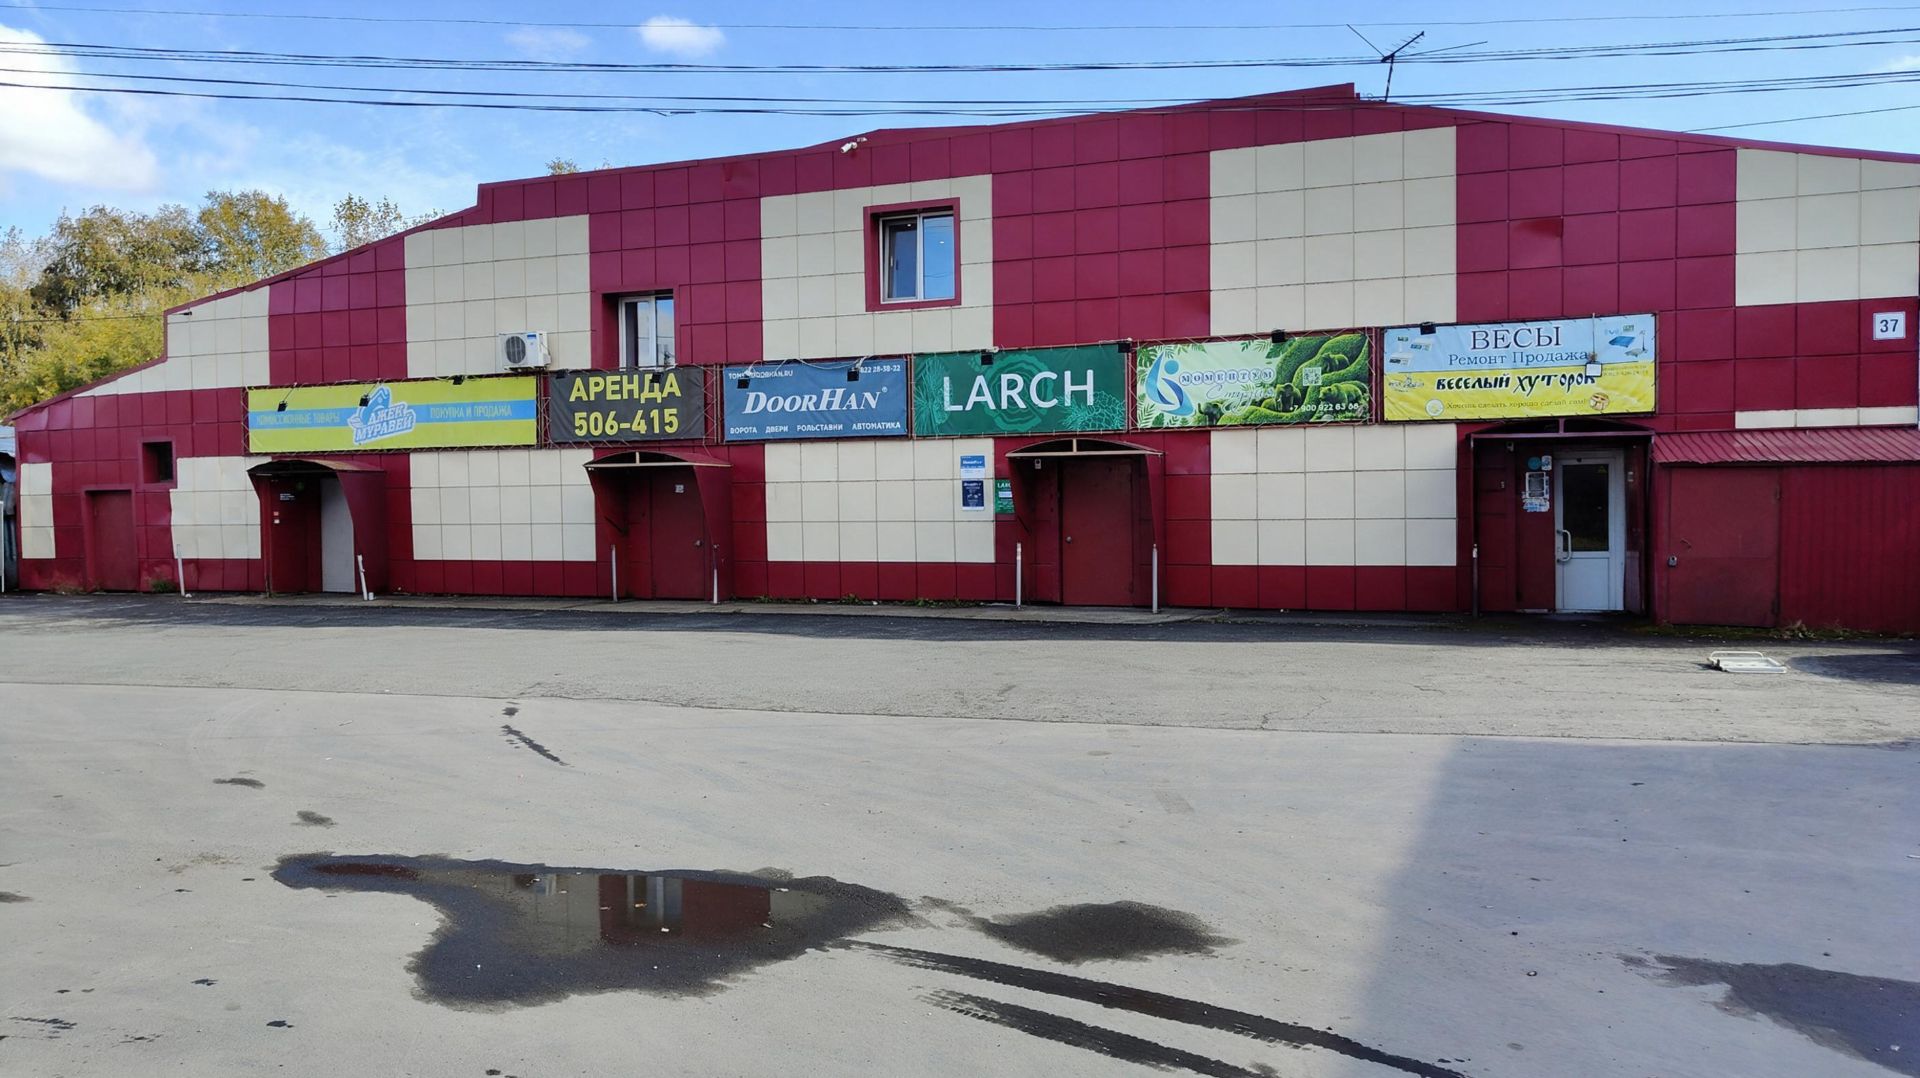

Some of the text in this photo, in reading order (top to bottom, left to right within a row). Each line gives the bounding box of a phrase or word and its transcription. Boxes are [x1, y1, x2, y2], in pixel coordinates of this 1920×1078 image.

[1880, 319, 1899, 333] 37
[1471, 326, 1562, 350] ВЕСЫ
[1449, 351, 1589, 366] Ремонт Продажа
[569, 372, 682, 404] АРЕНДА
[1181, 370, 1273, 384] МОМЕНТУМ
[943, 369, 1094, 412] LARCH
[370, 404, 405, 424] ДЖЕК
[574, 408, 679, 437] 506-415
[356, 411, 414, 441] МУРАВЕЙ
[730, 422, 901, 435] ВОРОТА ДВЕРИ РОЛЬСТАВНИ АВТОМАТИКА
